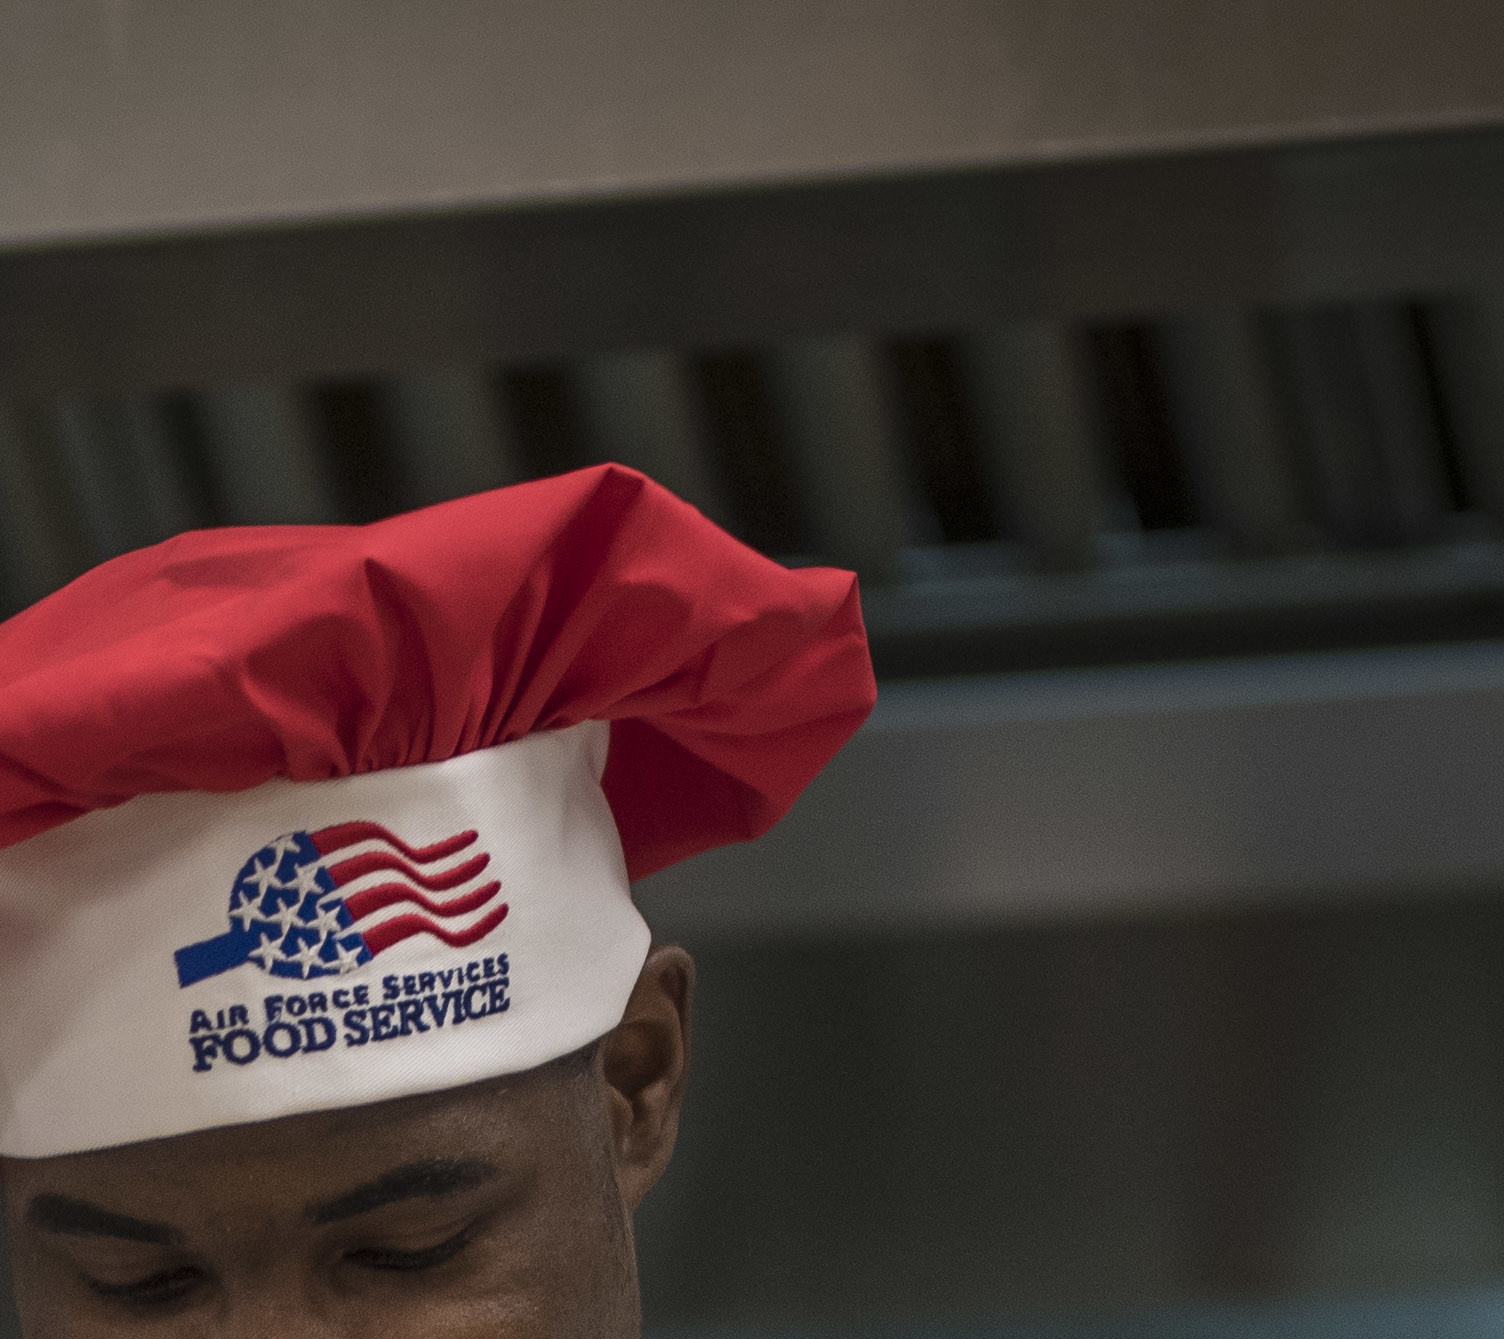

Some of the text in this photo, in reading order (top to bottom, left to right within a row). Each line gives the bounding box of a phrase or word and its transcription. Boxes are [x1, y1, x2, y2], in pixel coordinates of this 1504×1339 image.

[190, 953, 510, 1034] AIR FORCE SERVICES
[191, 976, 510, 1072] FOOD SERVICE
